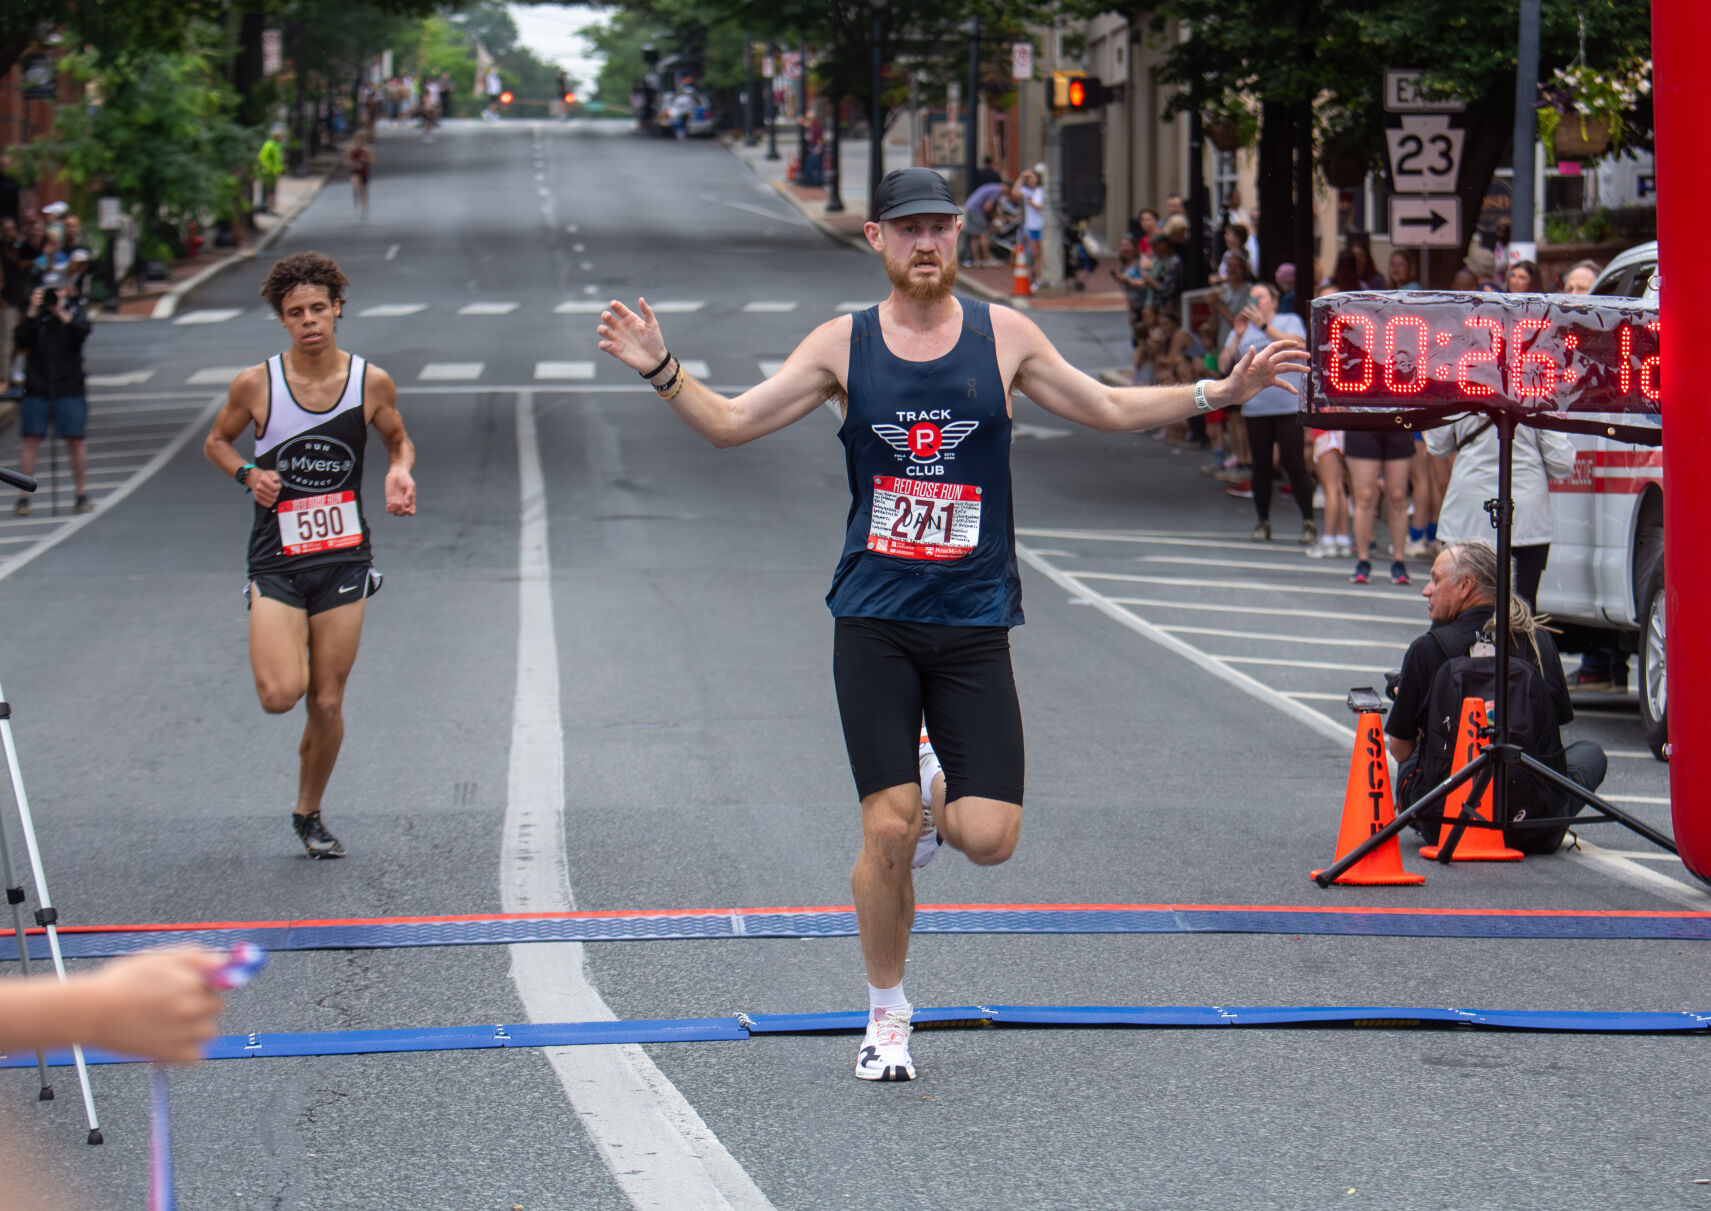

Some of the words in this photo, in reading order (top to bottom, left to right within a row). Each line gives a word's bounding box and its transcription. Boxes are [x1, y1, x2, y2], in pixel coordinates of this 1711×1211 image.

[1397, 135, 1453, 176] 23
[896, 409, 951, 422] TRACK
[305, 443, 331, 451] RUN
[916, 429, 934, 449] P
[291, 456, 341, 472] Myers
[906, 465, 944, 476] CLUB
[290, 474, 332, 486] PROJECT
[894, 478, 912, 494] RED
[912, 480, 939, 498] ROSE
[940, 484, 963, 500] RUN
[296, 506, 344, 540] 590
[891, 496, 955, 542] 271
[902, 509, 941, 531] DAN
